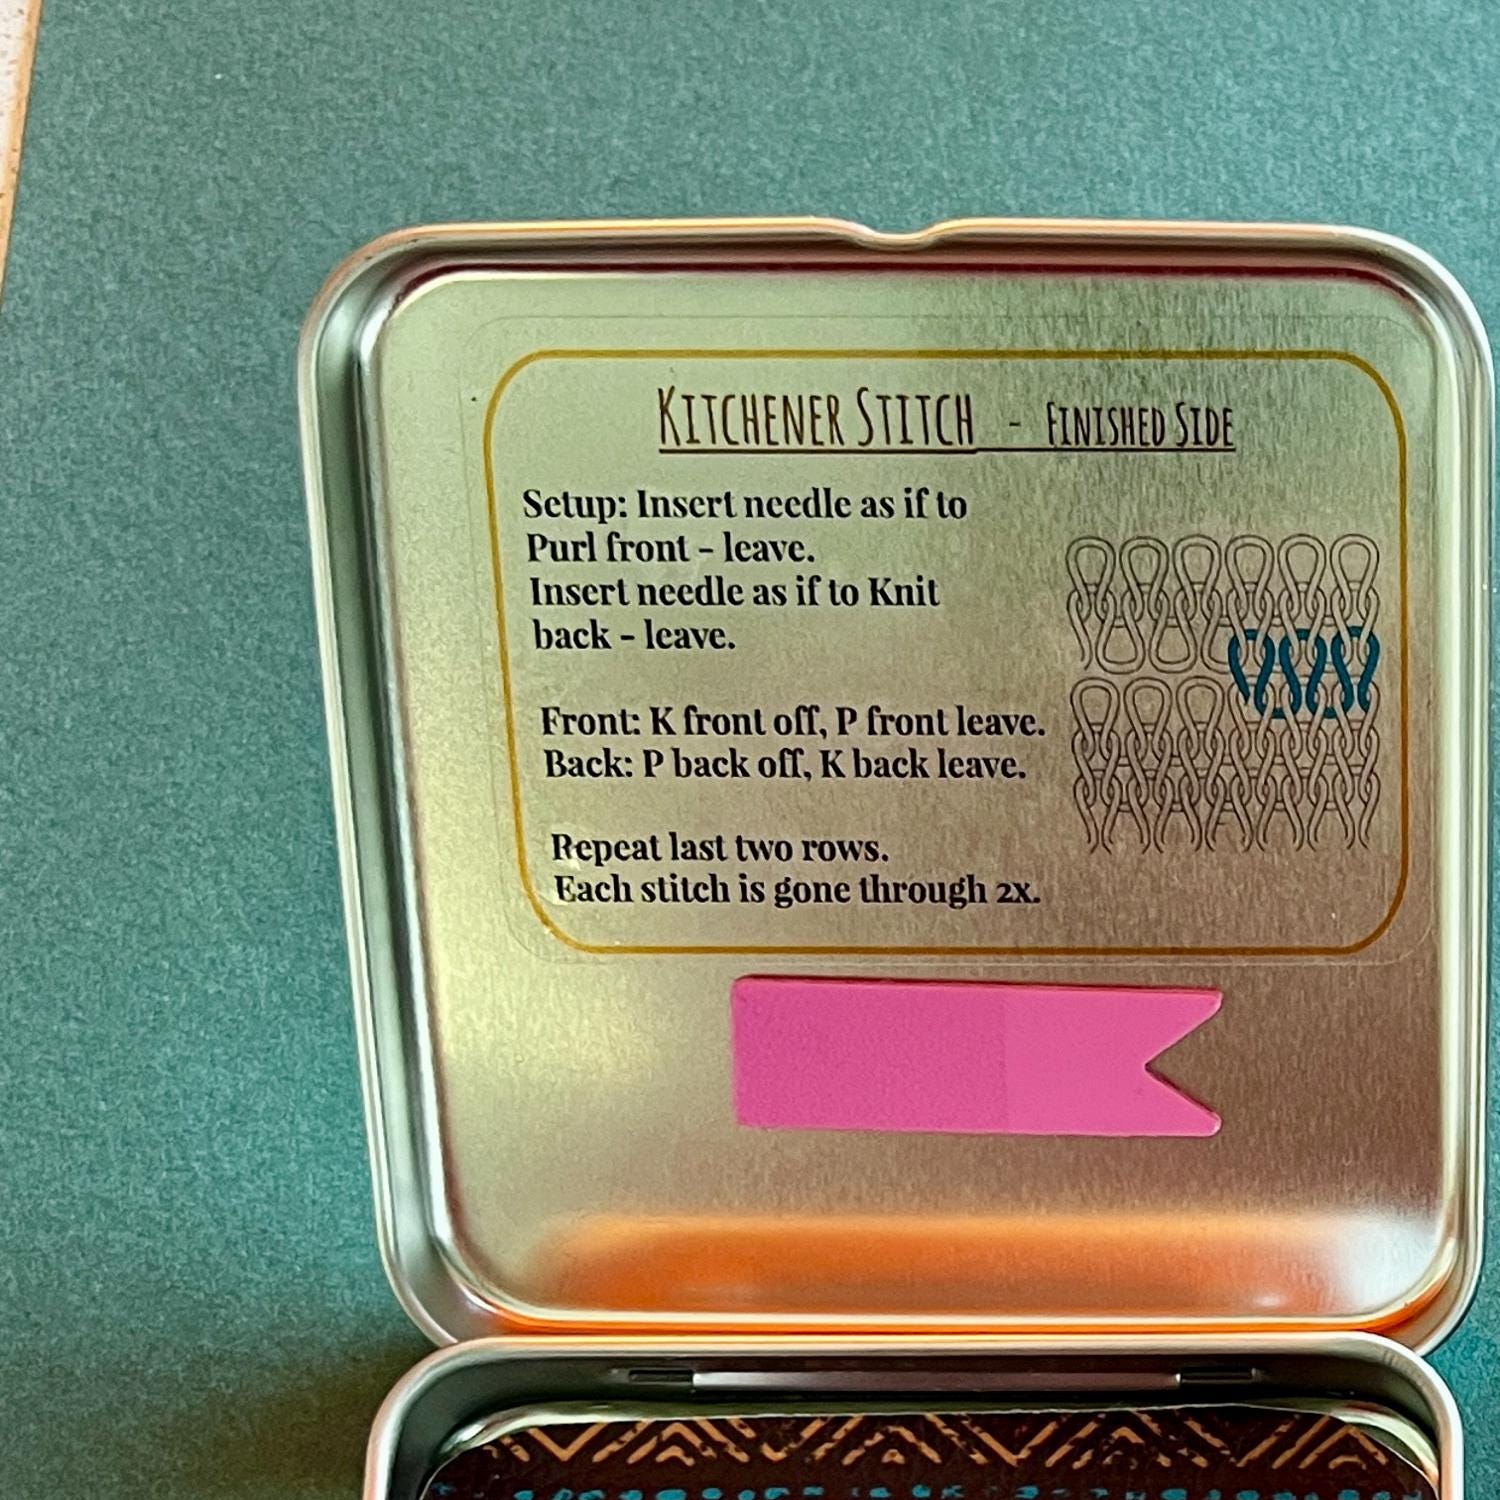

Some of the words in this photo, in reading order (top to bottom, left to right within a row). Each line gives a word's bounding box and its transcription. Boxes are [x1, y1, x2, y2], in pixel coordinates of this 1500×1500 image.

[657, 385, 843, 447] KITCHENER
[856, 386, 974, 447] STITCH
[1046, 400, 1166, 448] FINISHED
[1175, 400, 1234, 448] SIDE
[523, 489, 628, 525] Setup:
[637, 489, 738, 518] Insert
[743, 487, 852, 519] needle
[860, 496, 895, 519] as
[904, 486, 930, 519] if
[936, 491, 967, 520] to
[526, 530, 597, 562] Purl
[606, 531, 690, 562] front
[723, 531, 815, 563] leave.
[529, 577, 630, 606] Insert
[636, 575, 745, 607] needle
[752, 584, 788, 607] as
[795, 574, 822, 606] if
[828, 579, 859, 607] to
[867, 574, 941, 607] Knit
[532, 618, 612, 650] back
[643, 618, 736, 650] leave.
[540, 706, 641, 736] Front:
[649, 706, 676, 736] K
[683, 704, 767, 736] front
[773, 704, 828, 740] off,
[835, 706, 858, 736] P
[867, 704, 949, 736] front
[955, 704, 1046, 737] leave.
[543, 747, 633, 778] Back:
[642, 749, 664, 778] P
[671, 747, 750, 778] back
[758, 747, 812, 782] off,
[819, 749, 846, 779] K
[852, 746, 930, 779] back
[936, 747, 1027, 780] leave.
[551, 833, 662, 867] Repeat
[668, 831, 729, 862] last
[735, 834, 793, 862] two
[801, 839, 889, 863] rows.
[554, 873, 634, 903] Each
[640, 872, 731, 903] stitch
[738, 872, 766, 904] is
[774, 876, 851, 909] gone
[858, 873, 987, 910] through
[995, 881, 1042, 904] 2x.
